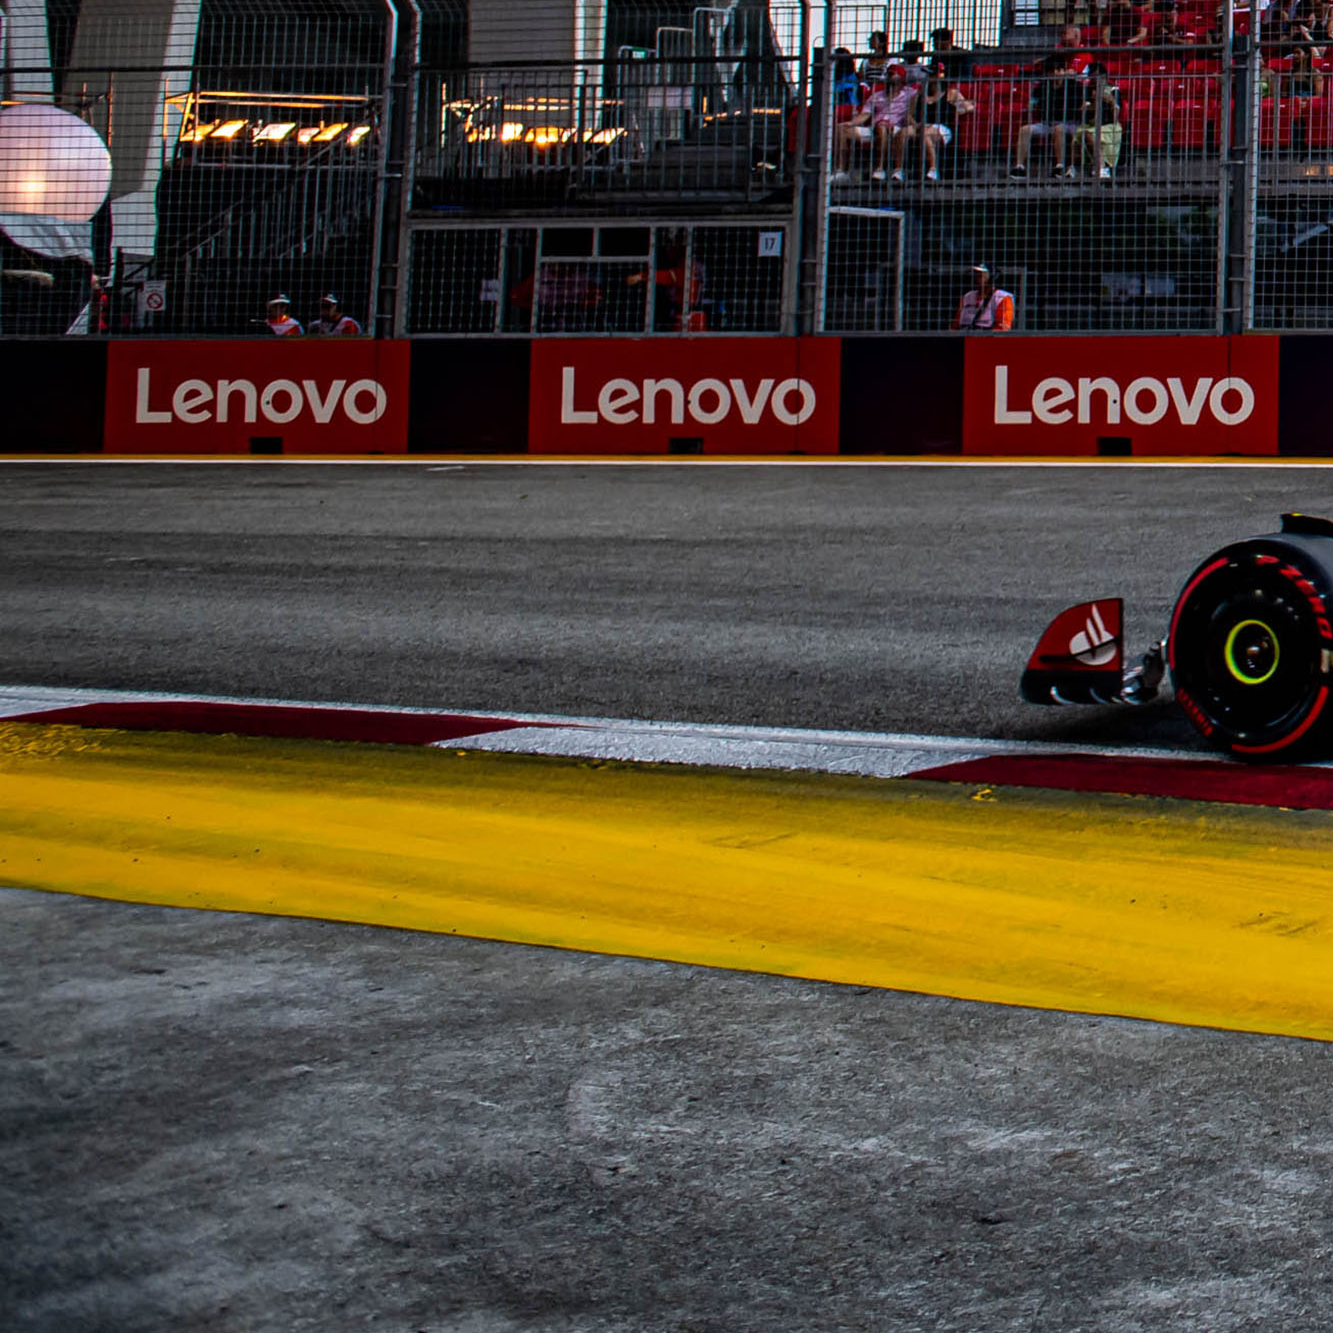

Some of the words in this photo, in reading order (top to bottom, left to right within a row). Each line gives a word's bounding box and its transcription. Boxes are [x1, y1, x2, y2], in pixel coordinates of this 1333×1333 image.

[765, 237, 776, 251] 17
[139, 380, 386, 424] Lenovo
[561, 367, 816, 425] Lenovo
[994, 365, 1255, 425] Lenovo
